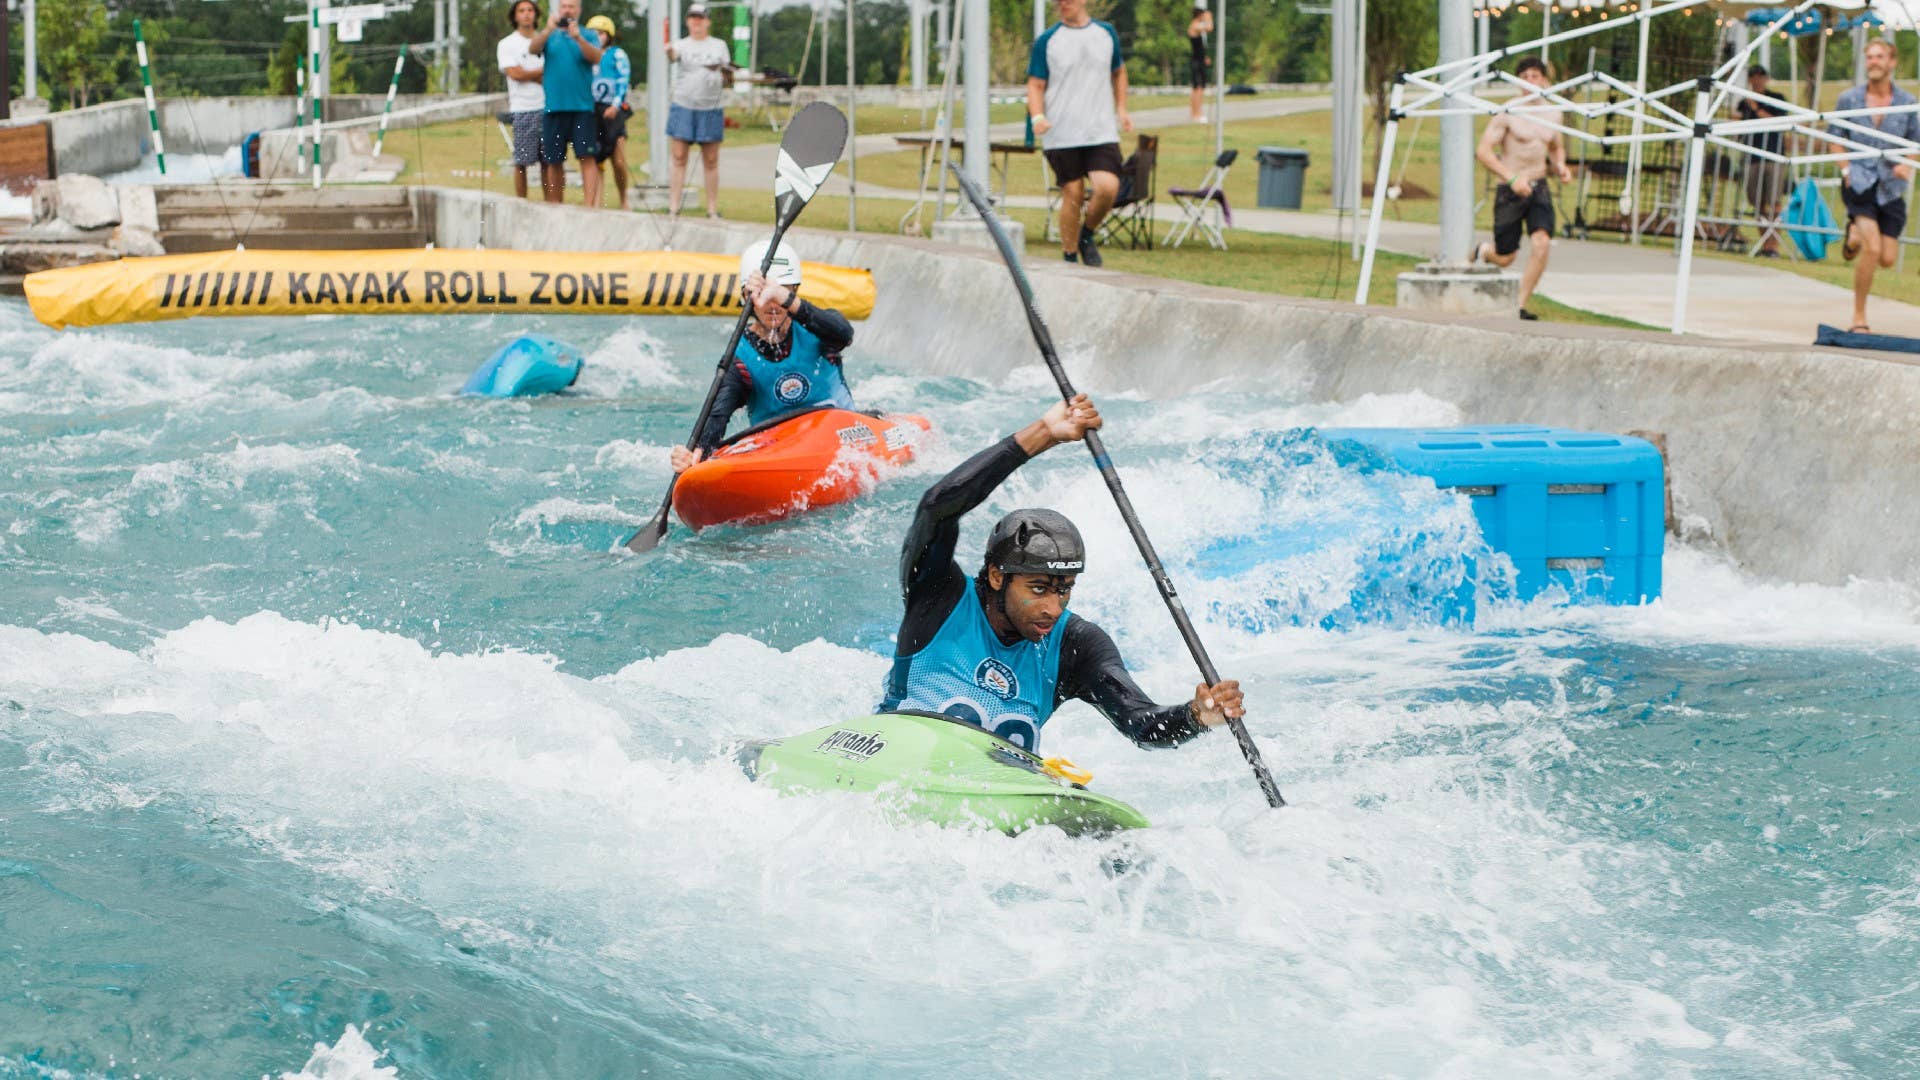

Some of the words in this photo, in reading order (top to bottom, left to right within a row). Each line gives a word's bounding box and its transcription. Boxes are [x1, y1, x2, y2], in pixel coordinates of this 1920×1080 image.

[288, 271, 411, 305] KAYAK
[424, 271, 518, 304] ROLL
[529, 272, 629, 305] ZONE
